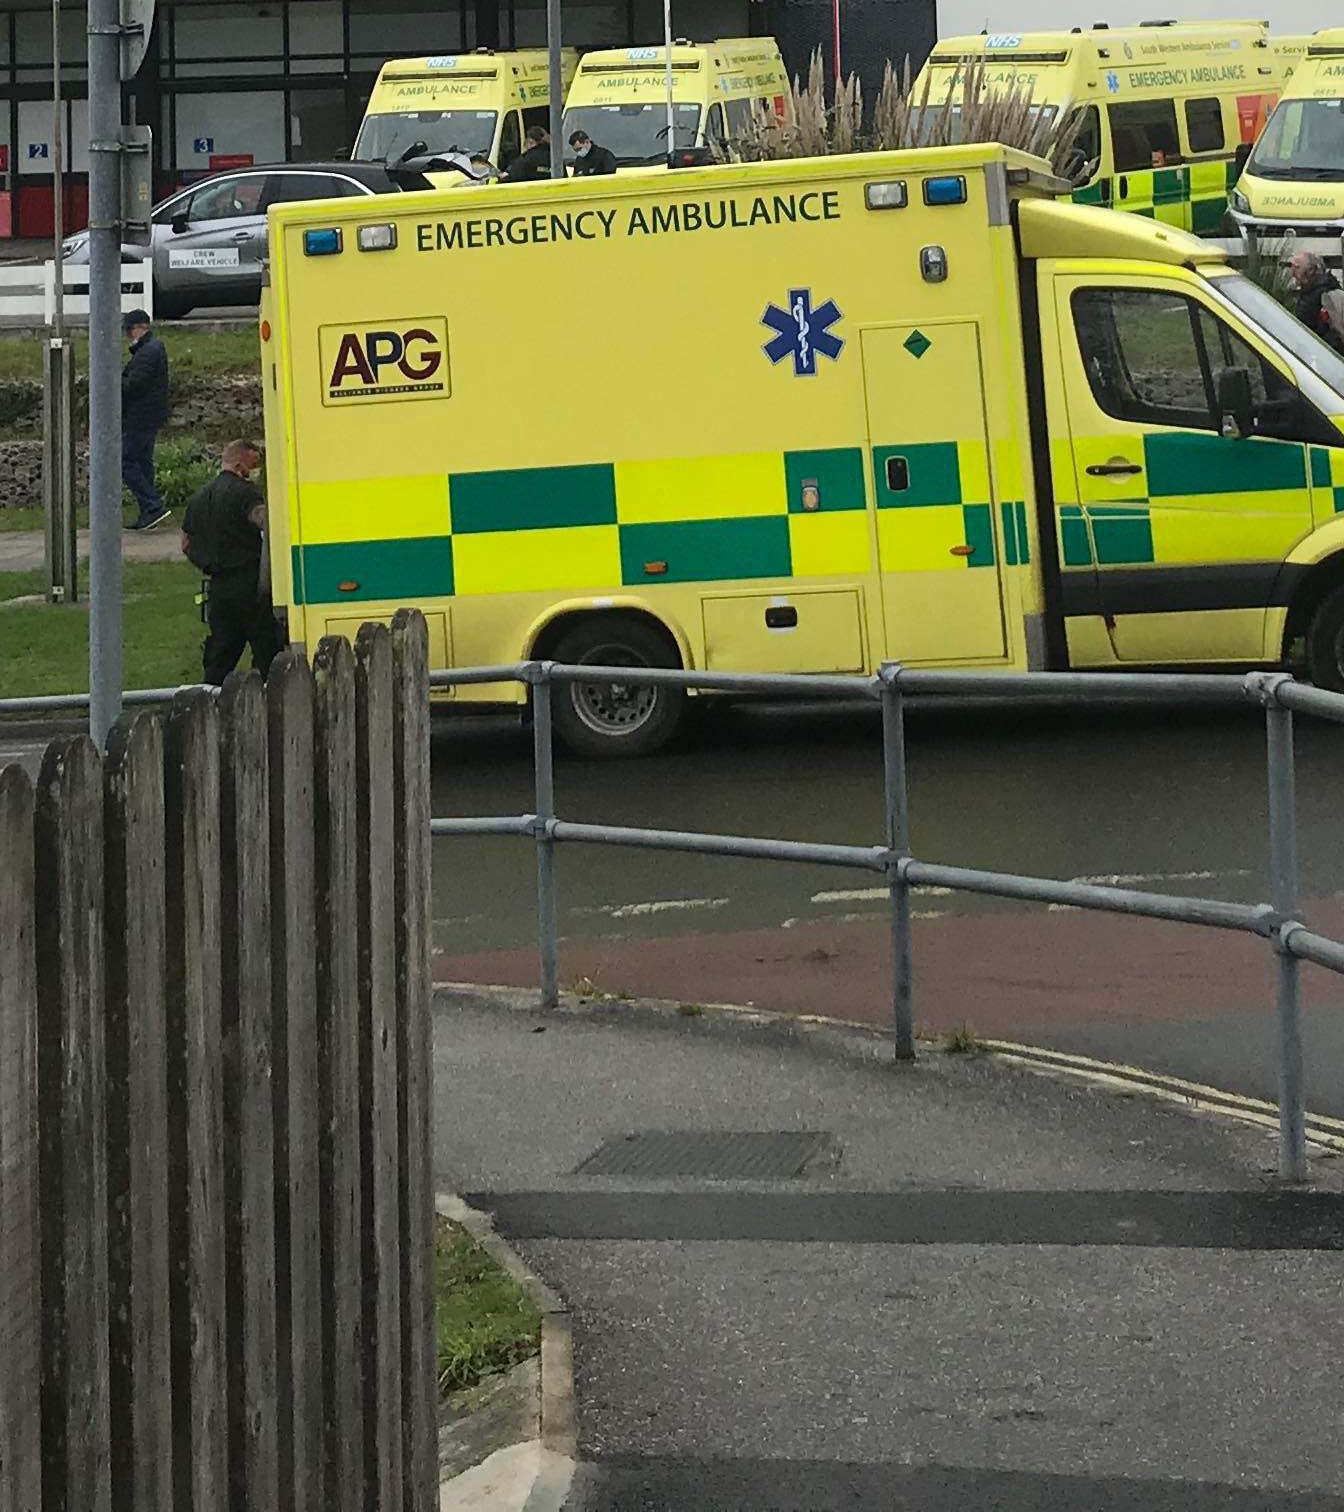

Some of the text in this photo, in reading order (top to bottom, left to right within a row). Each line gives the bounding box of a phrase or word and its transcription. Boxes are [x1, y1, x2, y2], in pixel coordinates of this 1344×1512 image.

[984, 35, 1022, 48] NHS
[627, 49, 657, 59] NHS
[1282, 44, 1307, 55] Servi
[1128, 64, 1247, 88] EMERGENCY AMBULANCE
[597, 77, 679, 88] AMBULANCE
[397, 85, 479, 97] AMBULANCE
[34, 143, 43, 159] 2
[198, 138, 209, 153] 3
[417, 191, 841, 252] EMERGENCY AMBULANCE
[194, 250, 215, 258] CREW
[207, 257, 237, 265] VEHICLE
[329, 328, 442, 388] APG
